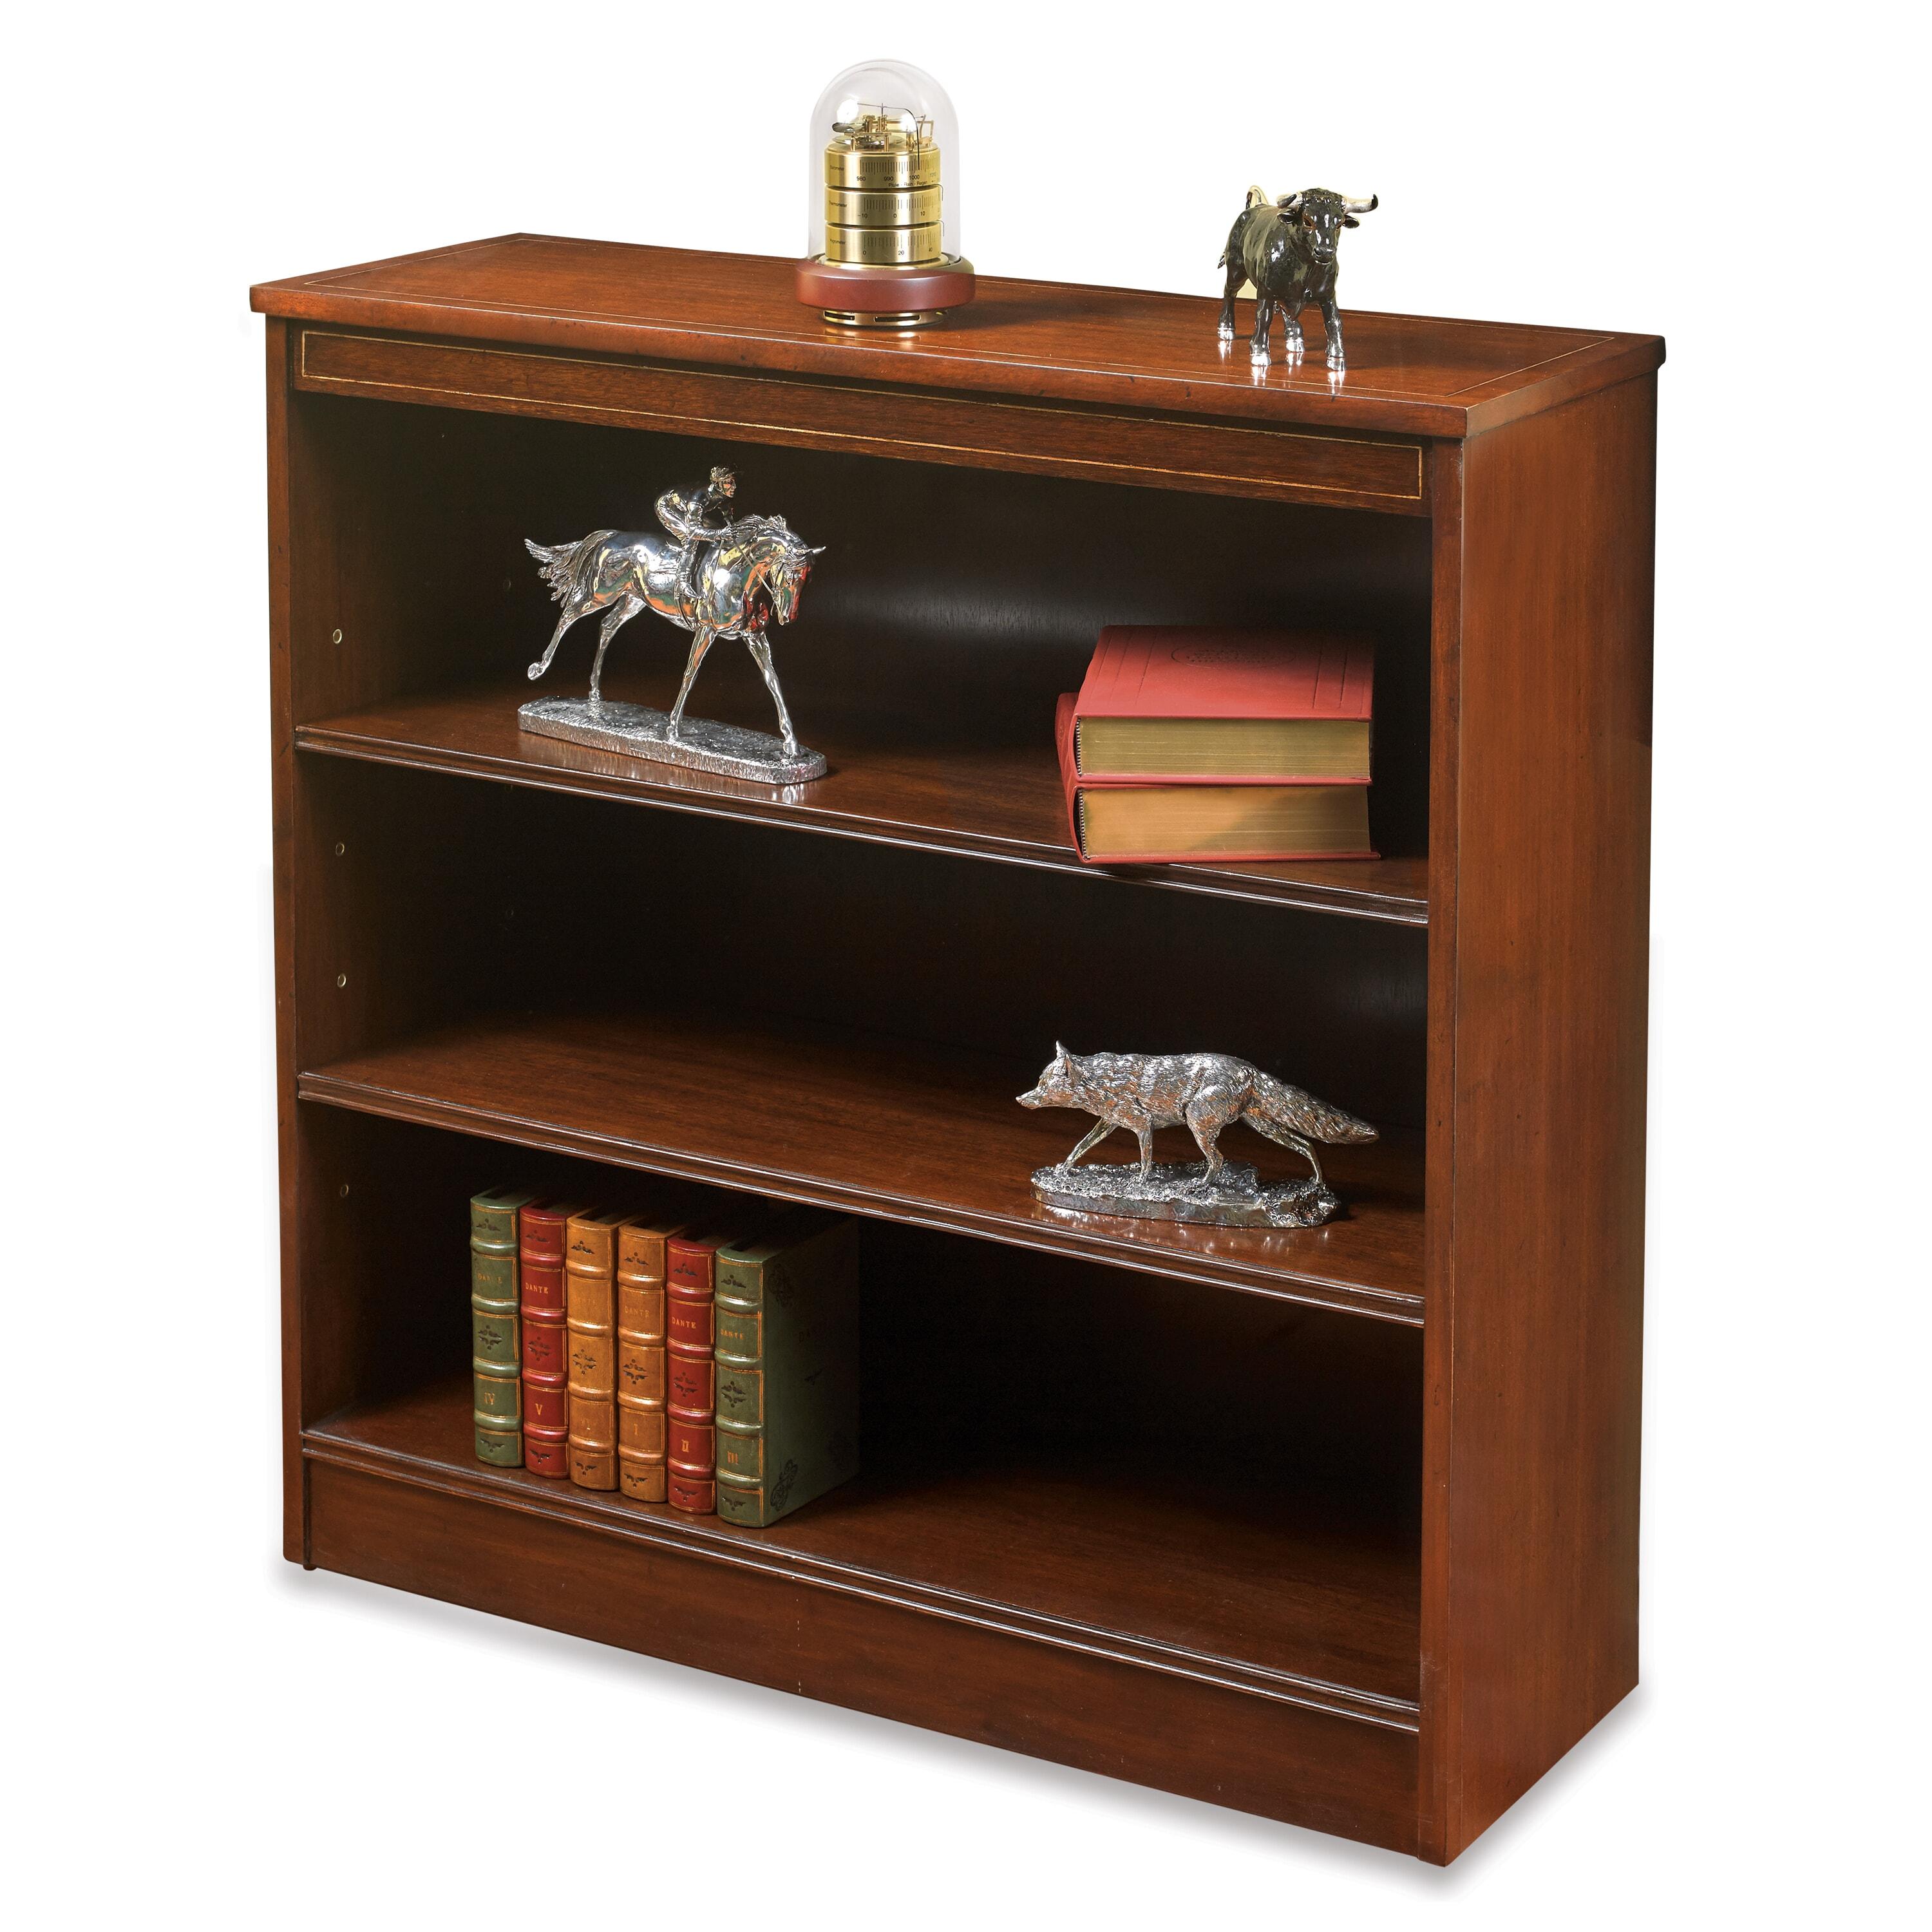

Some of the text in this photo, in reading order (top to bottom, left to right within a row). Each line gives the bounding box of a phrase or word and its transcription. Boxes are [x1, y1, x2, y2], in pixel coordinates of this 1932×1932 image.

[478, 1273, 502, 1283] DANE
[526, 1282, 549, 1294] DANTE
[625, 1305, 650, 1319] DANTE
[672, 1316, 696, 1329] DANTE
[720, 1329, 744, 1340] DANTE
[484, 1392, 495, 1405] IV
[535, 1403, 543, 1416] V
[681, 1439, 689, 1453] II
[727, 1450, 739, 1464] III
